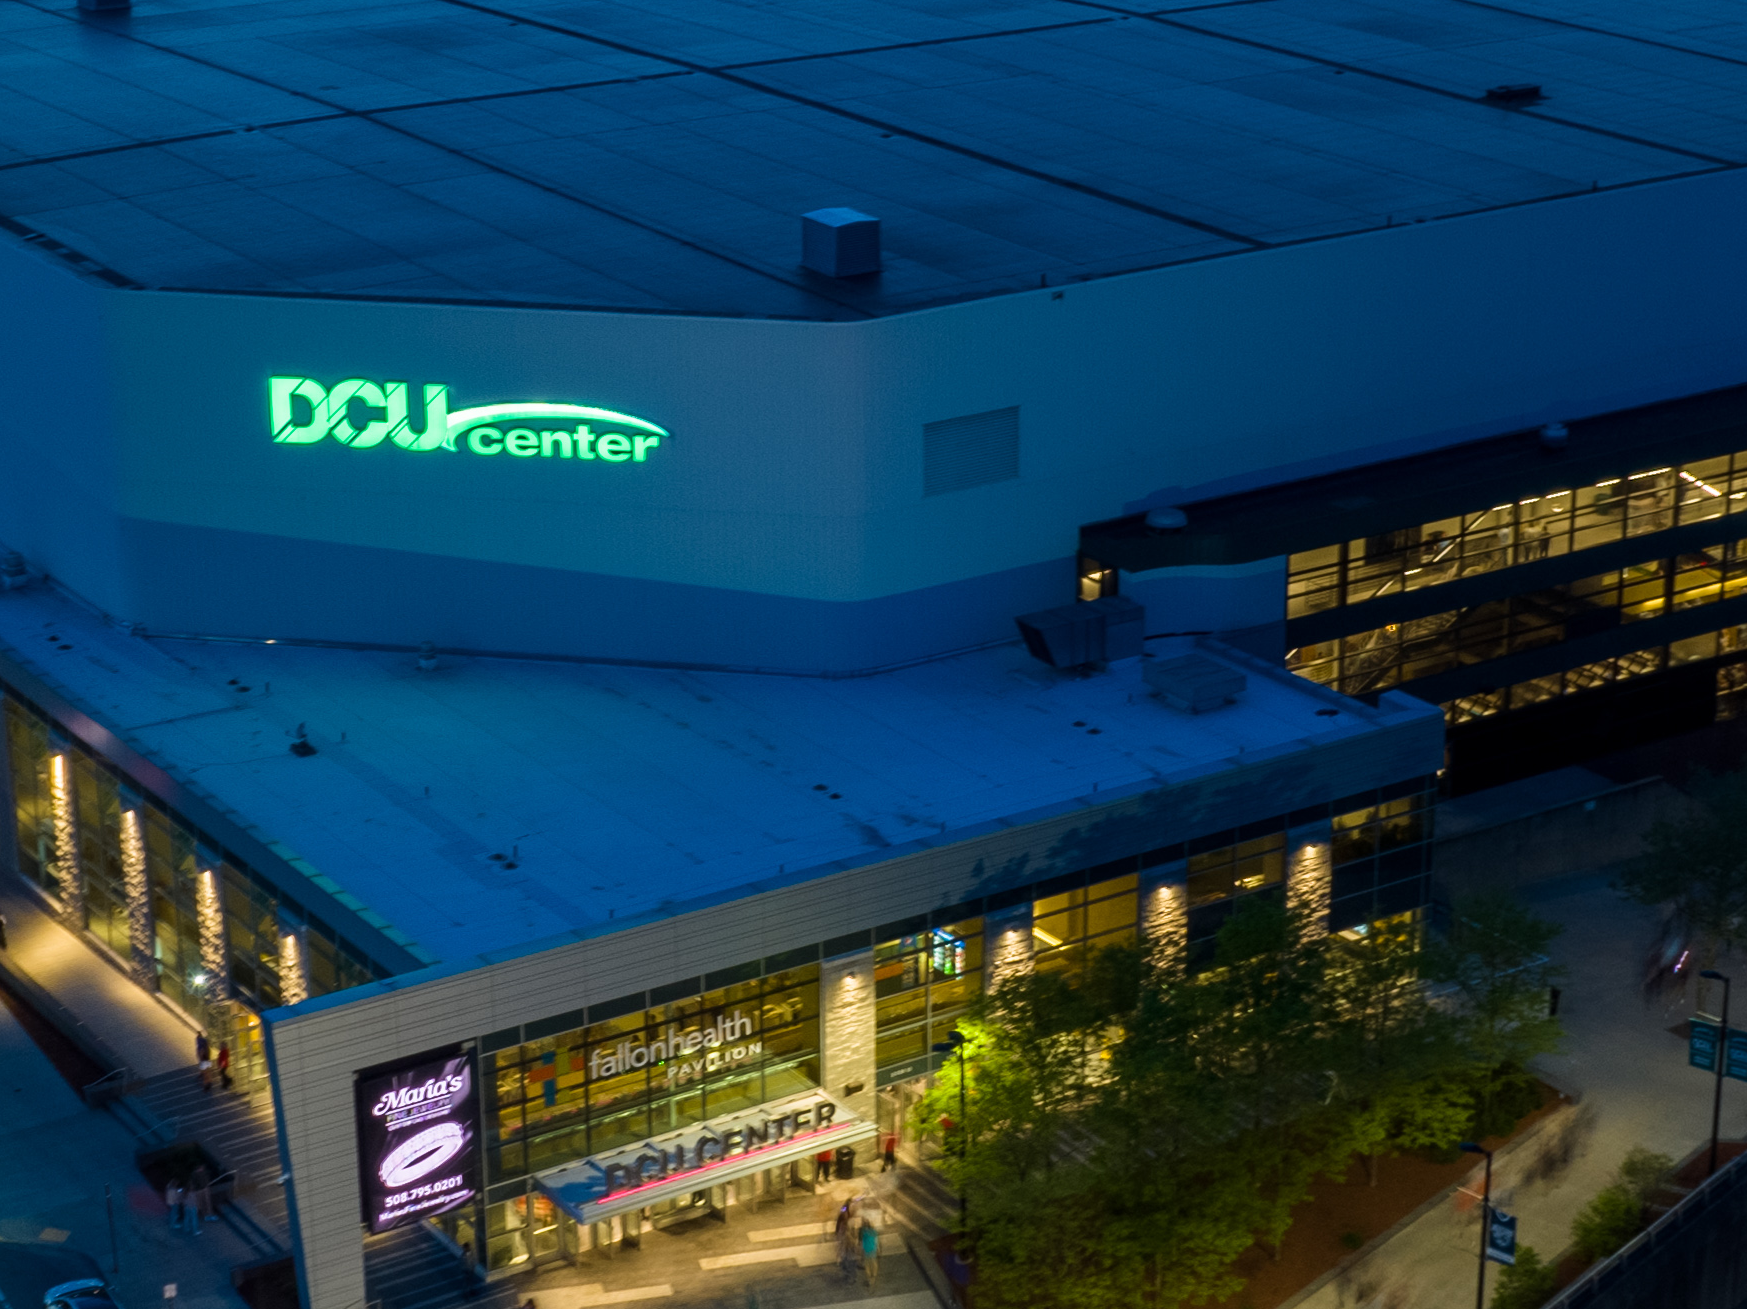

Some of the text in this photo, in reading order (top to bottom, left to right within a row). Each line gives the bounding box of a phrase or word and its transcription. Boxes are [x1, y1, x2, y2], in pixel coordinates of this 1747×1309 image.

[268, 375, 661, 462] DCU center
[587, 1008, 753, 1080] fallonhealth
[667, 1041, 763, 1079] PAVILION
[371, 1074, 464, 1117] Maria's
[607, 1101, 837, 1192] DCU CENTER
[384, 1174, 463, 1208] 508.795.0201
